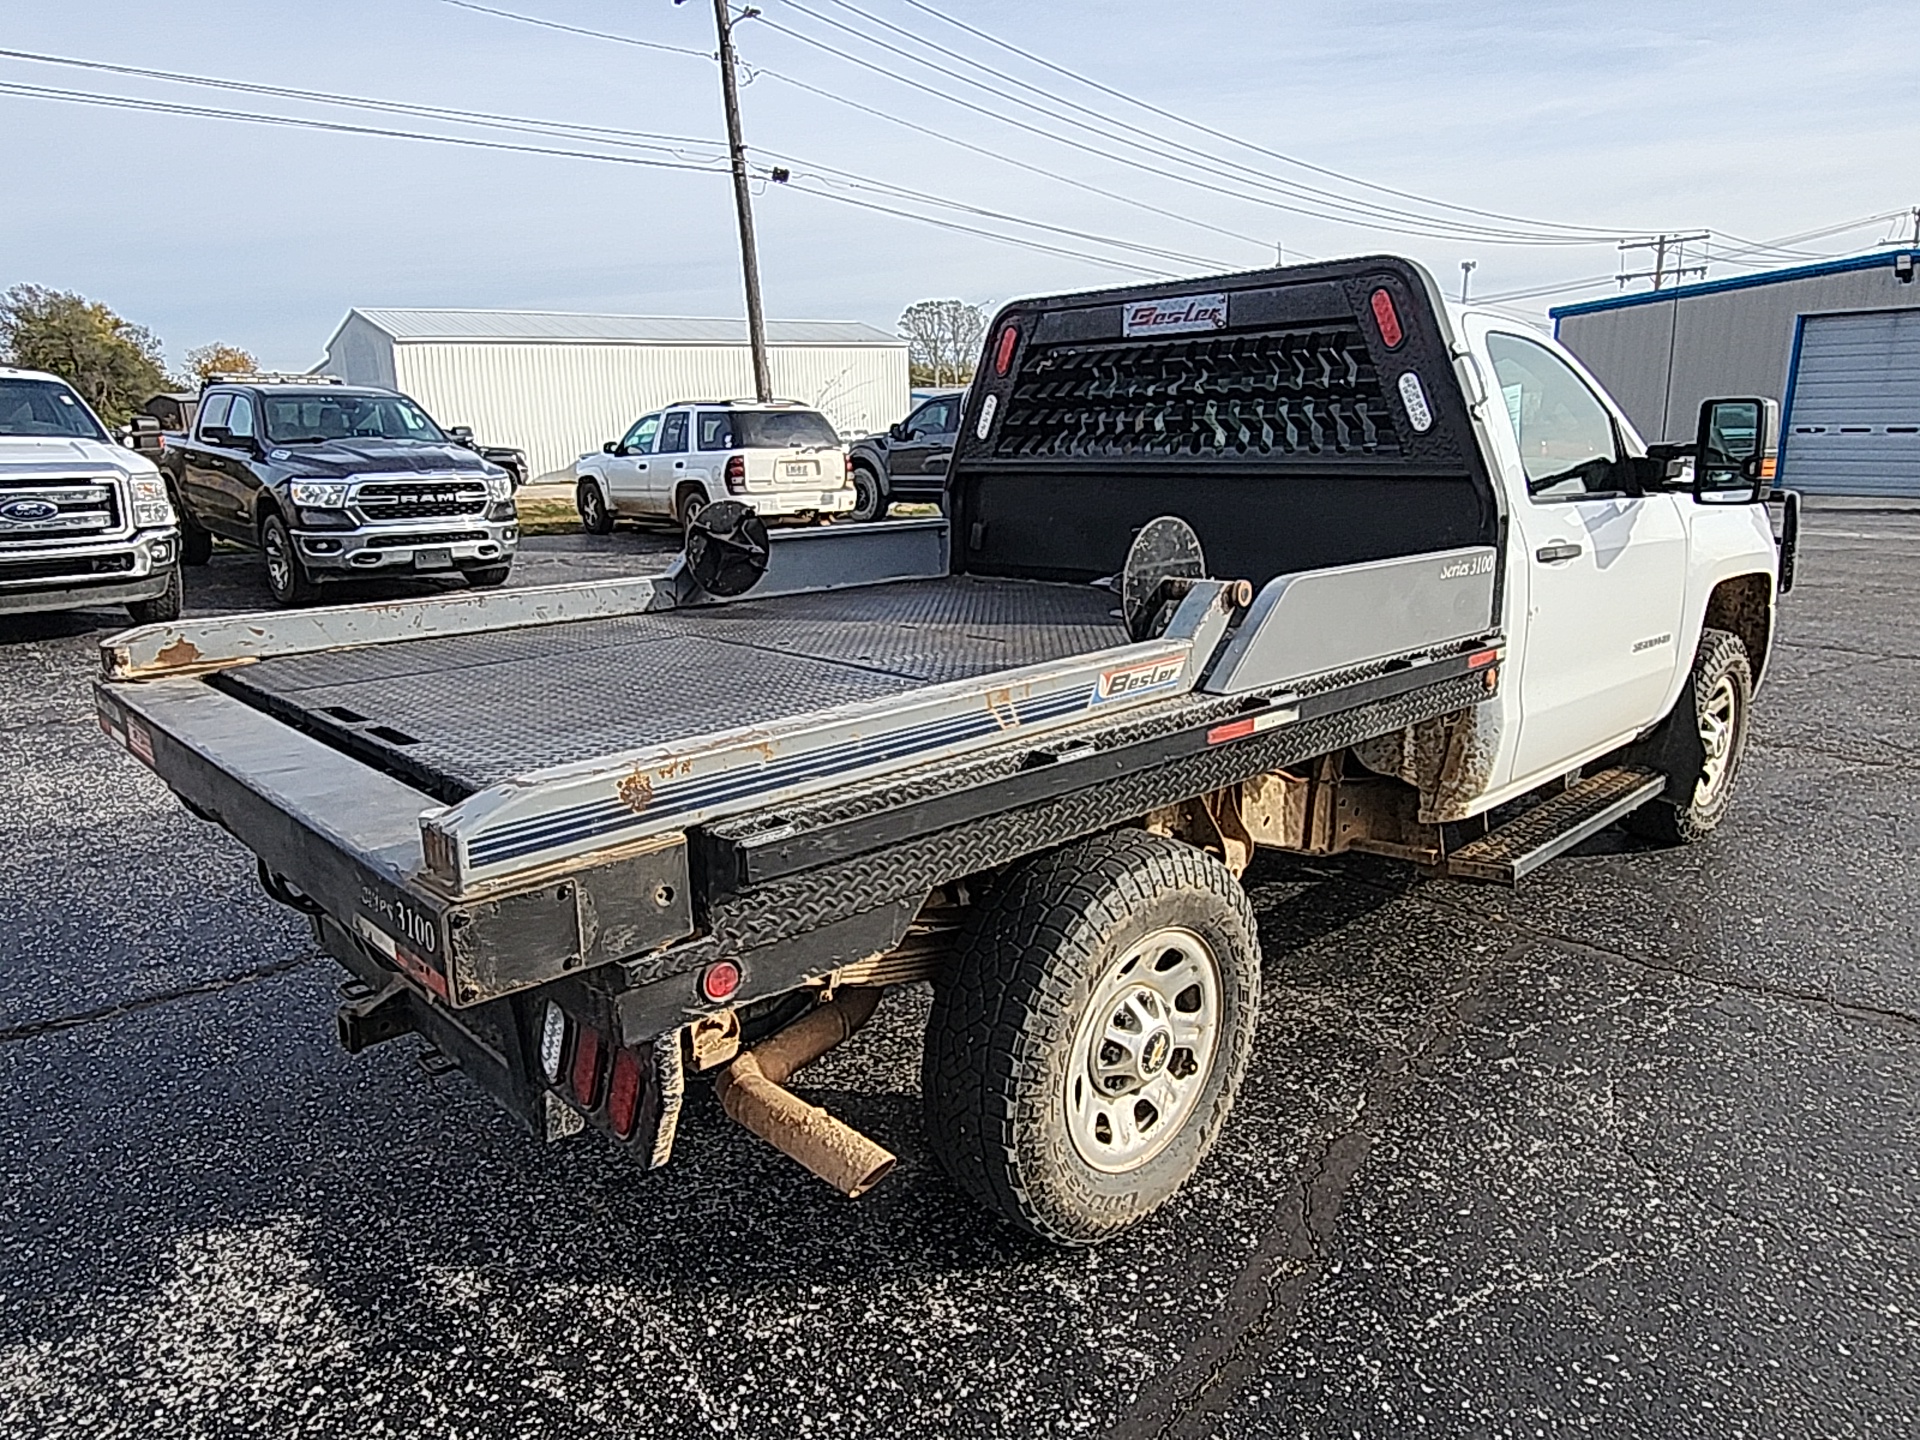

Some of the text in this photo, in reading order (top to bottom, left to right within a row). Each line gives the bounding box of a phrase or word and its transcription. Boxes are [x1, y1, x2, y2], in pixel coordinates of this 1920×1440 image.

[400, 493, 454, 503] RAM
[1440, 555, 1493, 579] Series 3100
[1106, 666, 1177, 696] Besler
[396, 901, 435, 953] 3100
